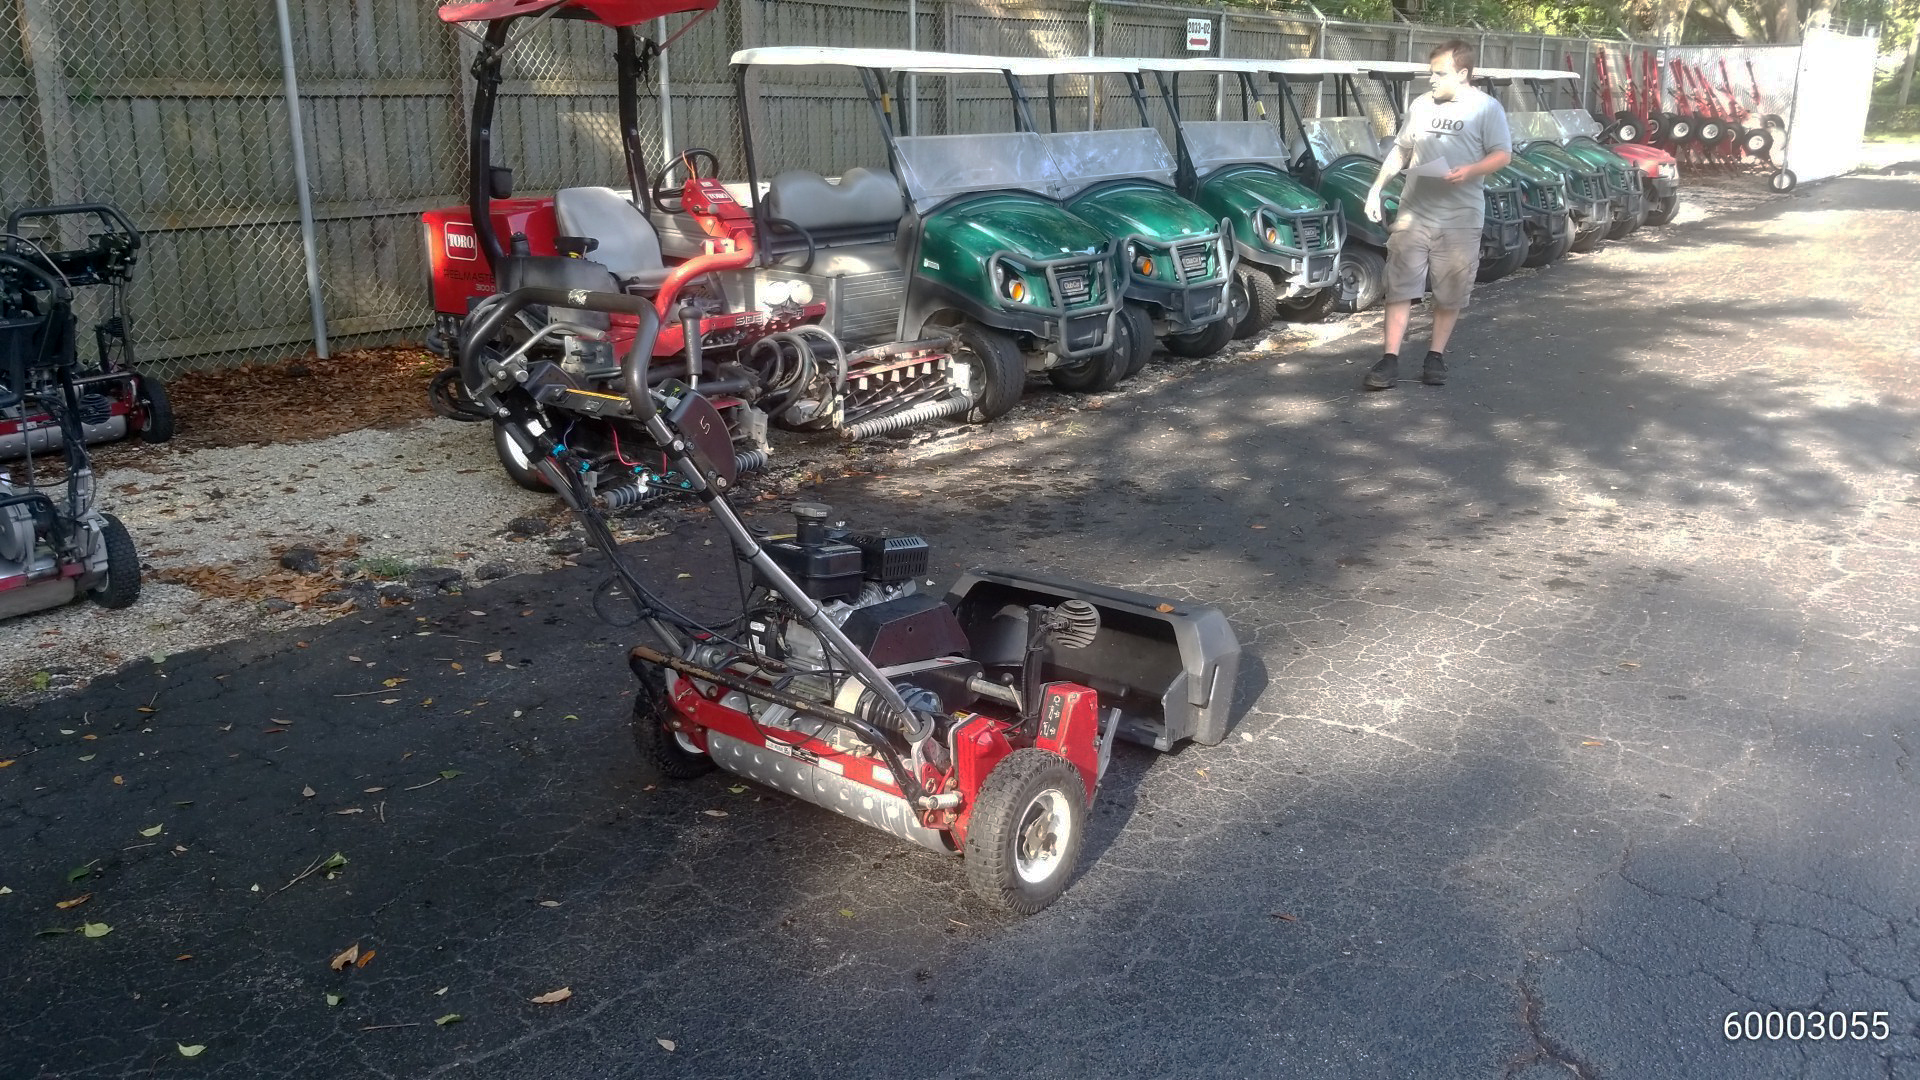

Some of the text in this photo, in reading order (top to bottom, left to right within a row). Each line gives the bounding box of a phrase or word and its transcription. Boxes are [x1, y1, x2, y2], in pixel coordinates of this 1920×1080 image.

[1430, 117, 1465, 132] ORO
[447, 233, 474, 249] TORO
[443, 268, 496, 284] REELMASTE
